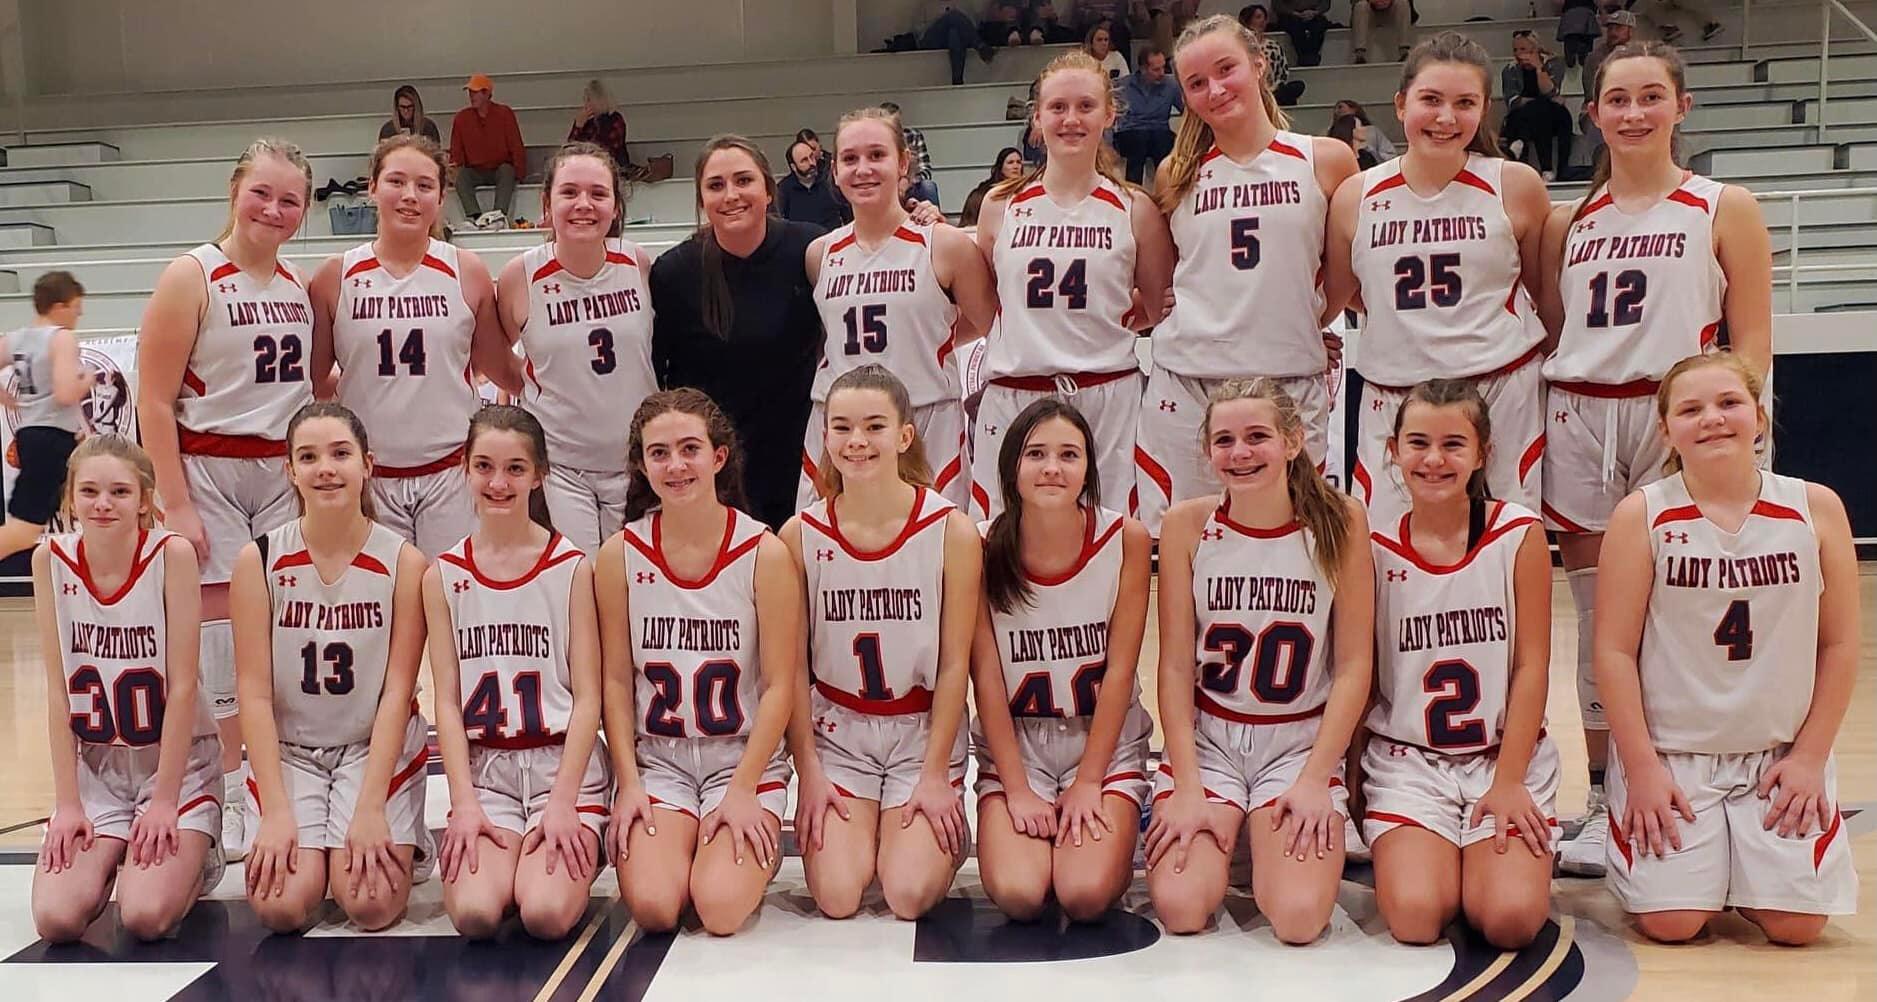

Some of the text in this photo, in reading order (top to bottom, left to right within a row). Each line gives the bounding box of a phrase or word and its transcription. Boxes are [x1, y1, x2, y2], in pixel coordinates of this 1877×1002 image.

[1194, 181, 1301, 216] LADY PATRIOTS
[1010, 225, 1112, 250] LADY PATRIOTS
[1230, 216, 1261, 271] 5
[1370, 216, 1486, 249] LADY PATRIOTS
[1568, 232, 1686, 268] LADY PATRIOTS
[825, 269, 915, 300] LADY PATRIOTS
[1027, 257, 1088, 309] 24
[1394, 252, 1462, 311] 25
[1586, 269, 1647, 328] 12
[227, 302, 309, 327] LADY PATRIOT
[352, 295, 449, 320] LADY PATRIOTS
[546, 288, 641, 326] LADY PATRIOTS
[843, 304, 888, 355] 15
[253, 333, 304, 384] 22
[377, 328, 426, 376] 14
[588, 327, 617, 375] 3
[1666, 552, 1800, 589] LADY PATRIOTS
[279, 601, 383, 631] LADY PATRIOTS
[823, 588, 922, 622] LADY PATRIOTS
[1207, 576, 1316, 615] LADY PATRIOTS
[488, 623, 550, 659] PATRIOTS
[642, 617, 740, 651] LADY PATRIOTS
[1009, 621, 1107, 663] LADY PATRIOT
[1399, 606, 1507, 653] LADY PATRIOTS
[1713, 600, 1754, 661] 4
[301, 640, 355, 696] 13
[852, 632, 895, 700] 1
[69, 664, 167, 747] 30
[463, 670, 550, 740] 41
[643, 659, 745, 738] 20
[1422, 658, 1489, 750] 2
